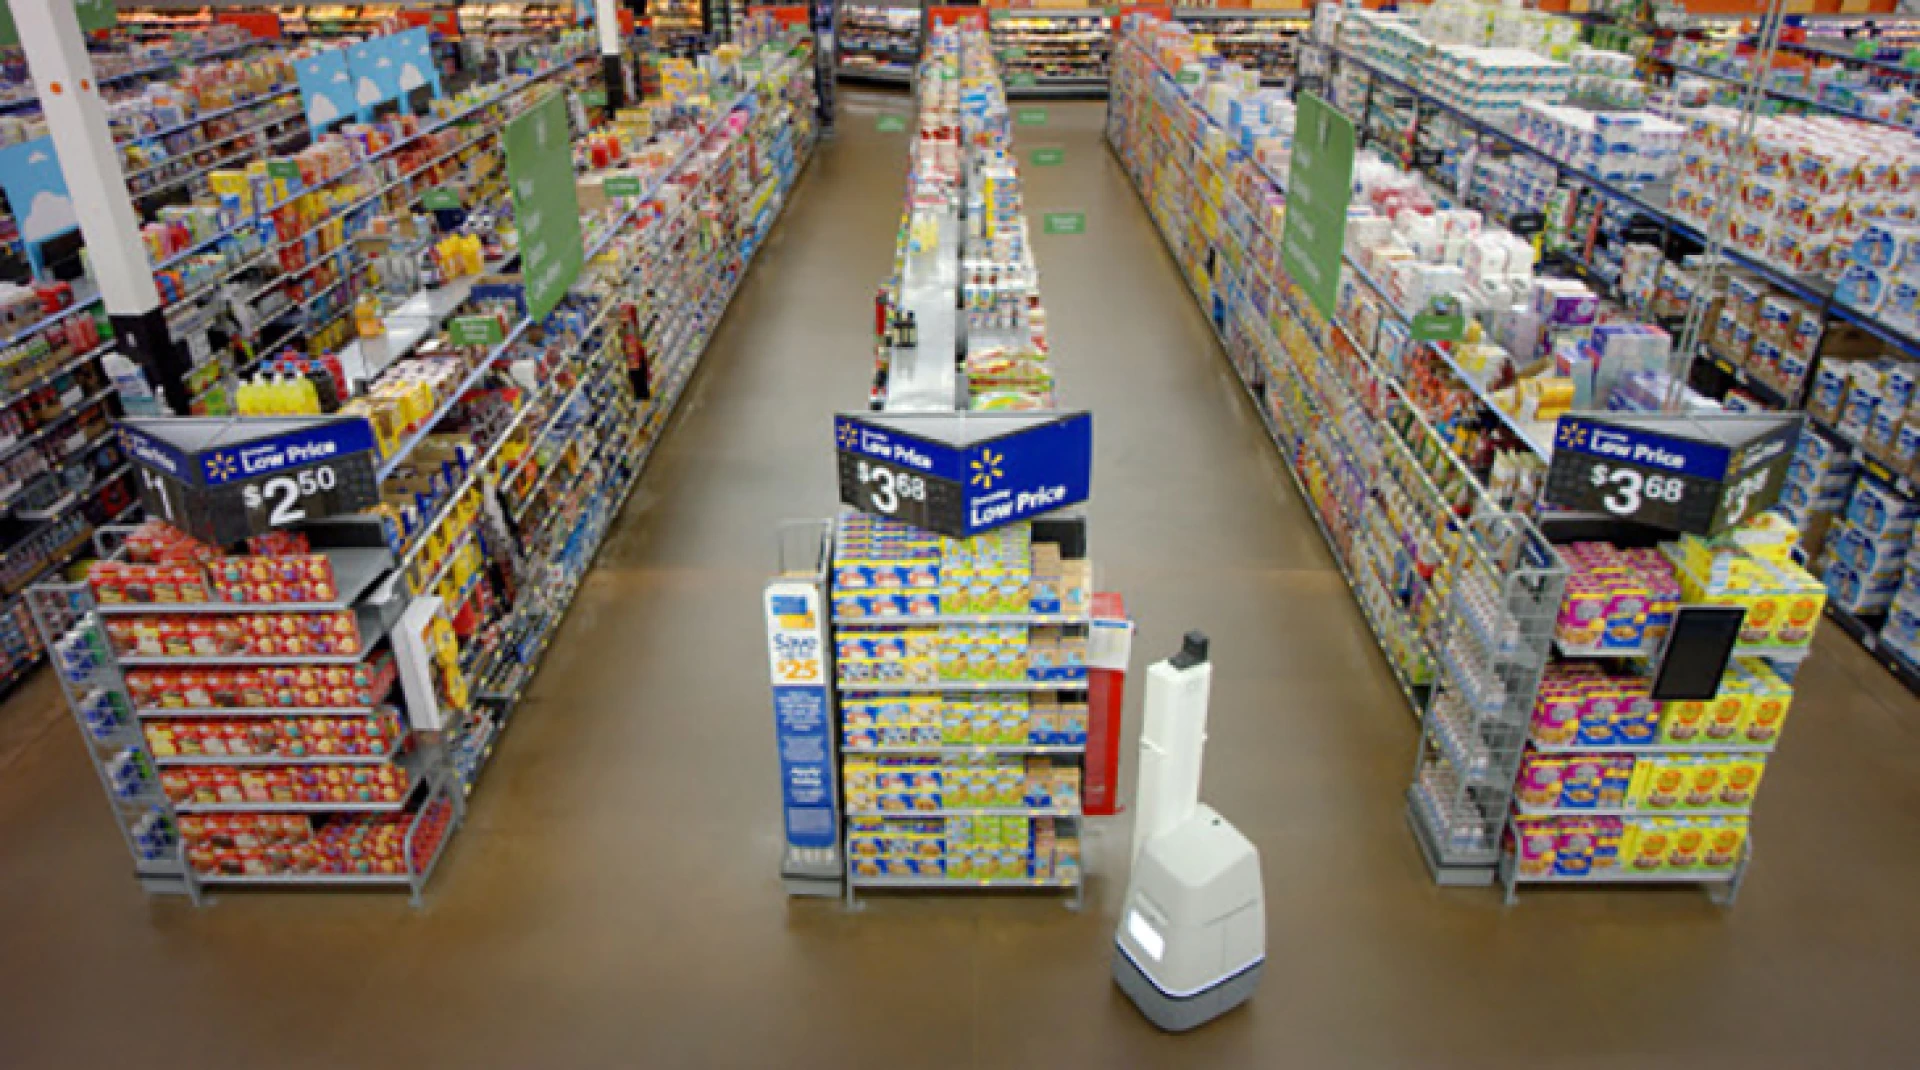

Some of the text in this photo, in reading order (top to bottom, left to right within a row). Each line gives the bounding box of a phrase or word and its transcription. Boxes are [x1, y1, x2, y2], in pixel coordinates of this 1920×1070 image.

[286, 441, 337, 462] Price
[1633, 444, 1686, 469] Price
[970, 501, 1014, 527] Low
[1017, 485, 1067, 513] Price
